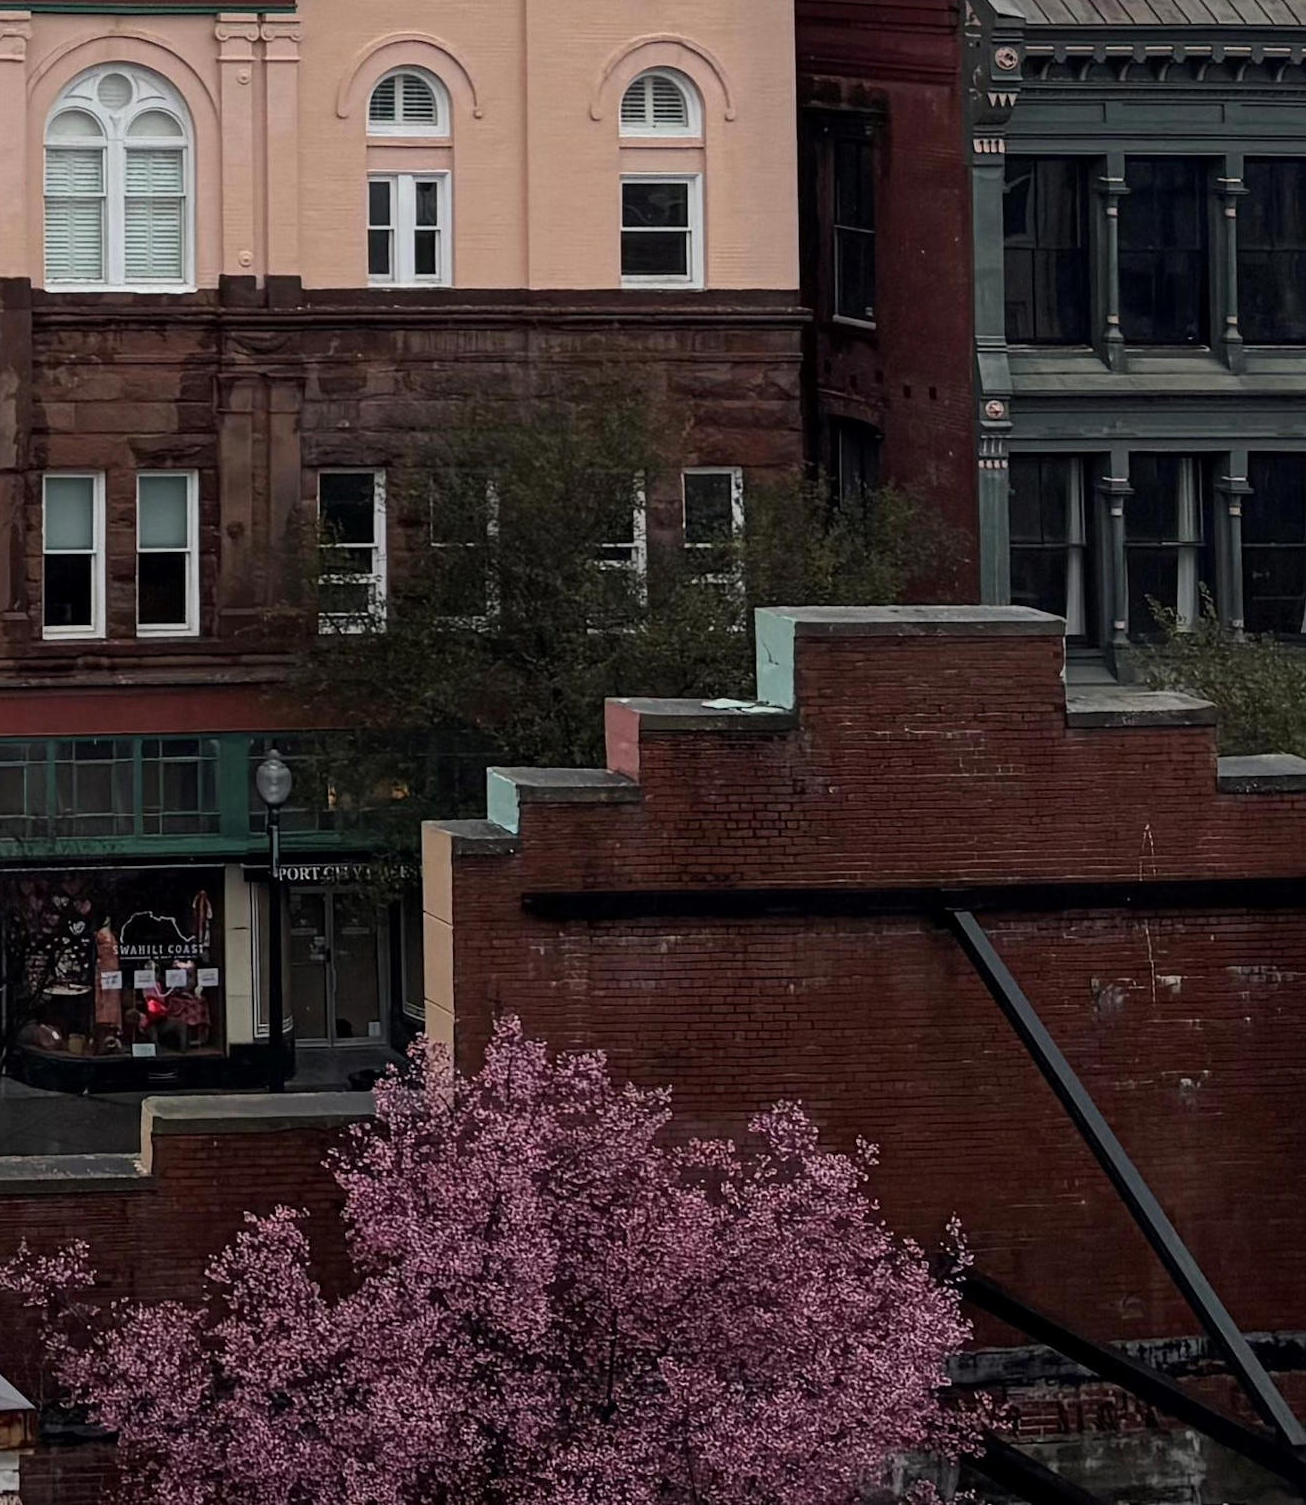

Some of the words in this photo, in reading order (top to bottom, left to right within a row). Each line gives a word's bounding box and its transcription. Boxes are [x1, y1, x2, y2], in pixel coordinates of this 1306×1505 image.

[279, 866, 321, 881] PORT
[112, 944, 163, 955] SWAHILI
[167, 943, 204, 955] COAST
